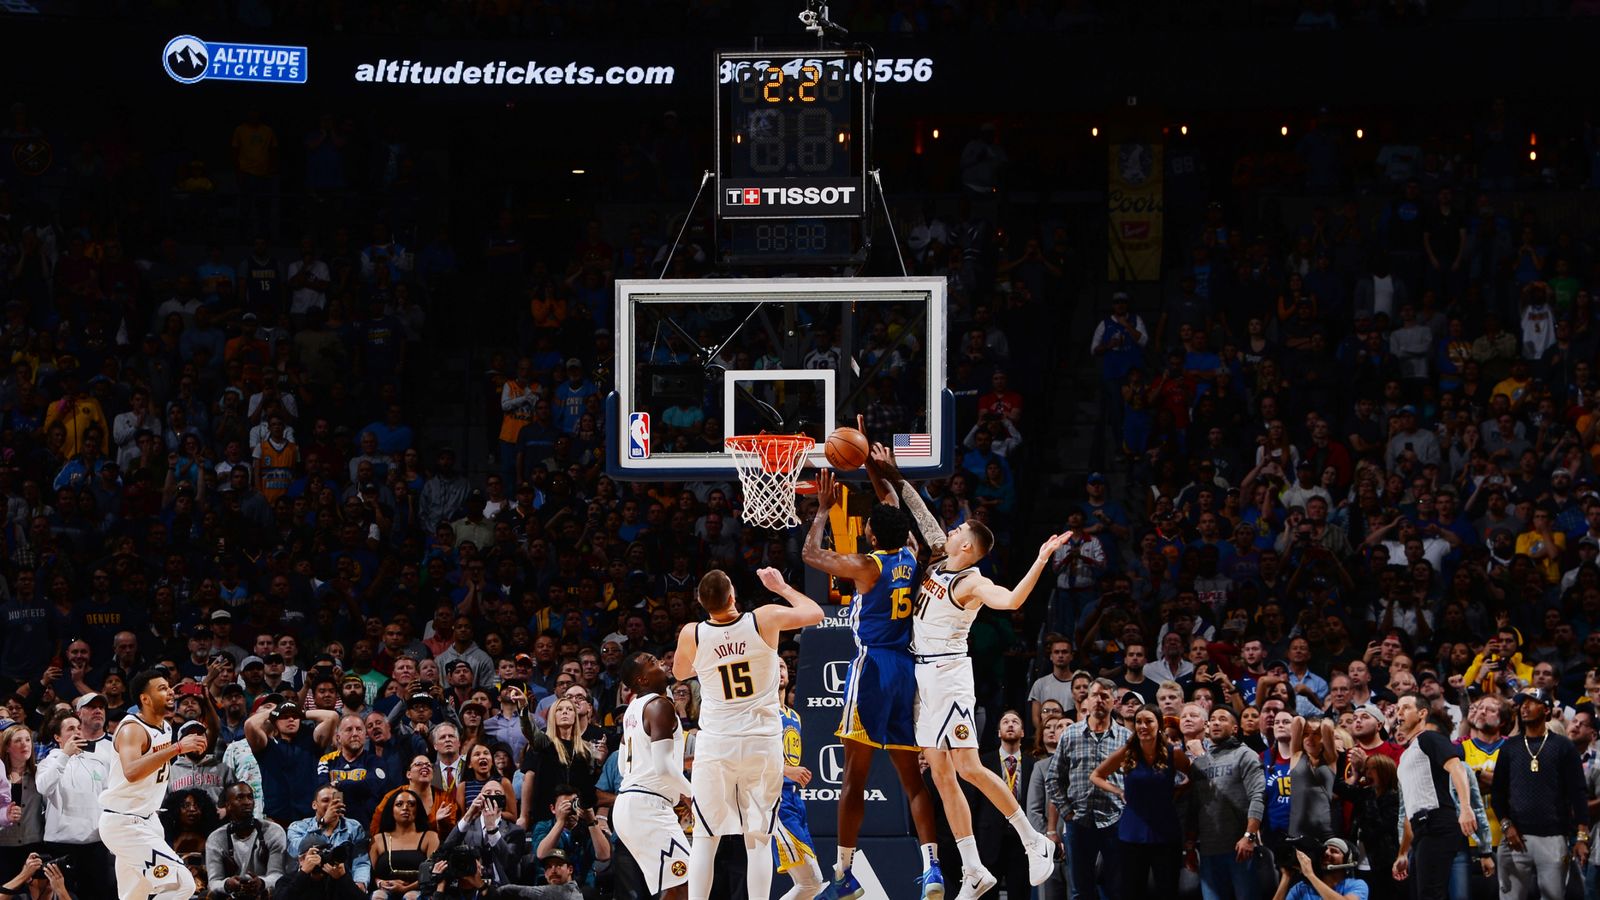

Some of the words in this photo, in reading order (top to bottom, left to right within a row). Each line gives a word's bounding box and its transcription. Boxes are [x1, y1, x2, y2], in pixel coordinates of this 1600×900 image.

[214, 47, 300, 66] ALTITUDE
[213, 63, 299, 78] TICKETS
[355, 59, 675, 86] altitudetickets.com
[762, 187, 856, 205] TISSOT
[892, 565, 913, 582] JONES
[890, 587, 912, 620] 15
[913, 592, 931, 620] 41
[86, 613, 121, 625] DENVER
[715, 642, 747, 659] JOKIĆ
[717, 661, 754, 700] 15
[807, 697, 844, 707] HON
[793, 737, 800, 749] 30
[1267, 770, 1282, 787] MILE
[1277, 776, 1292, 796] 15
[799, 788, 887, 801] HONA
[1277, 796, 1290, 804] CIT
